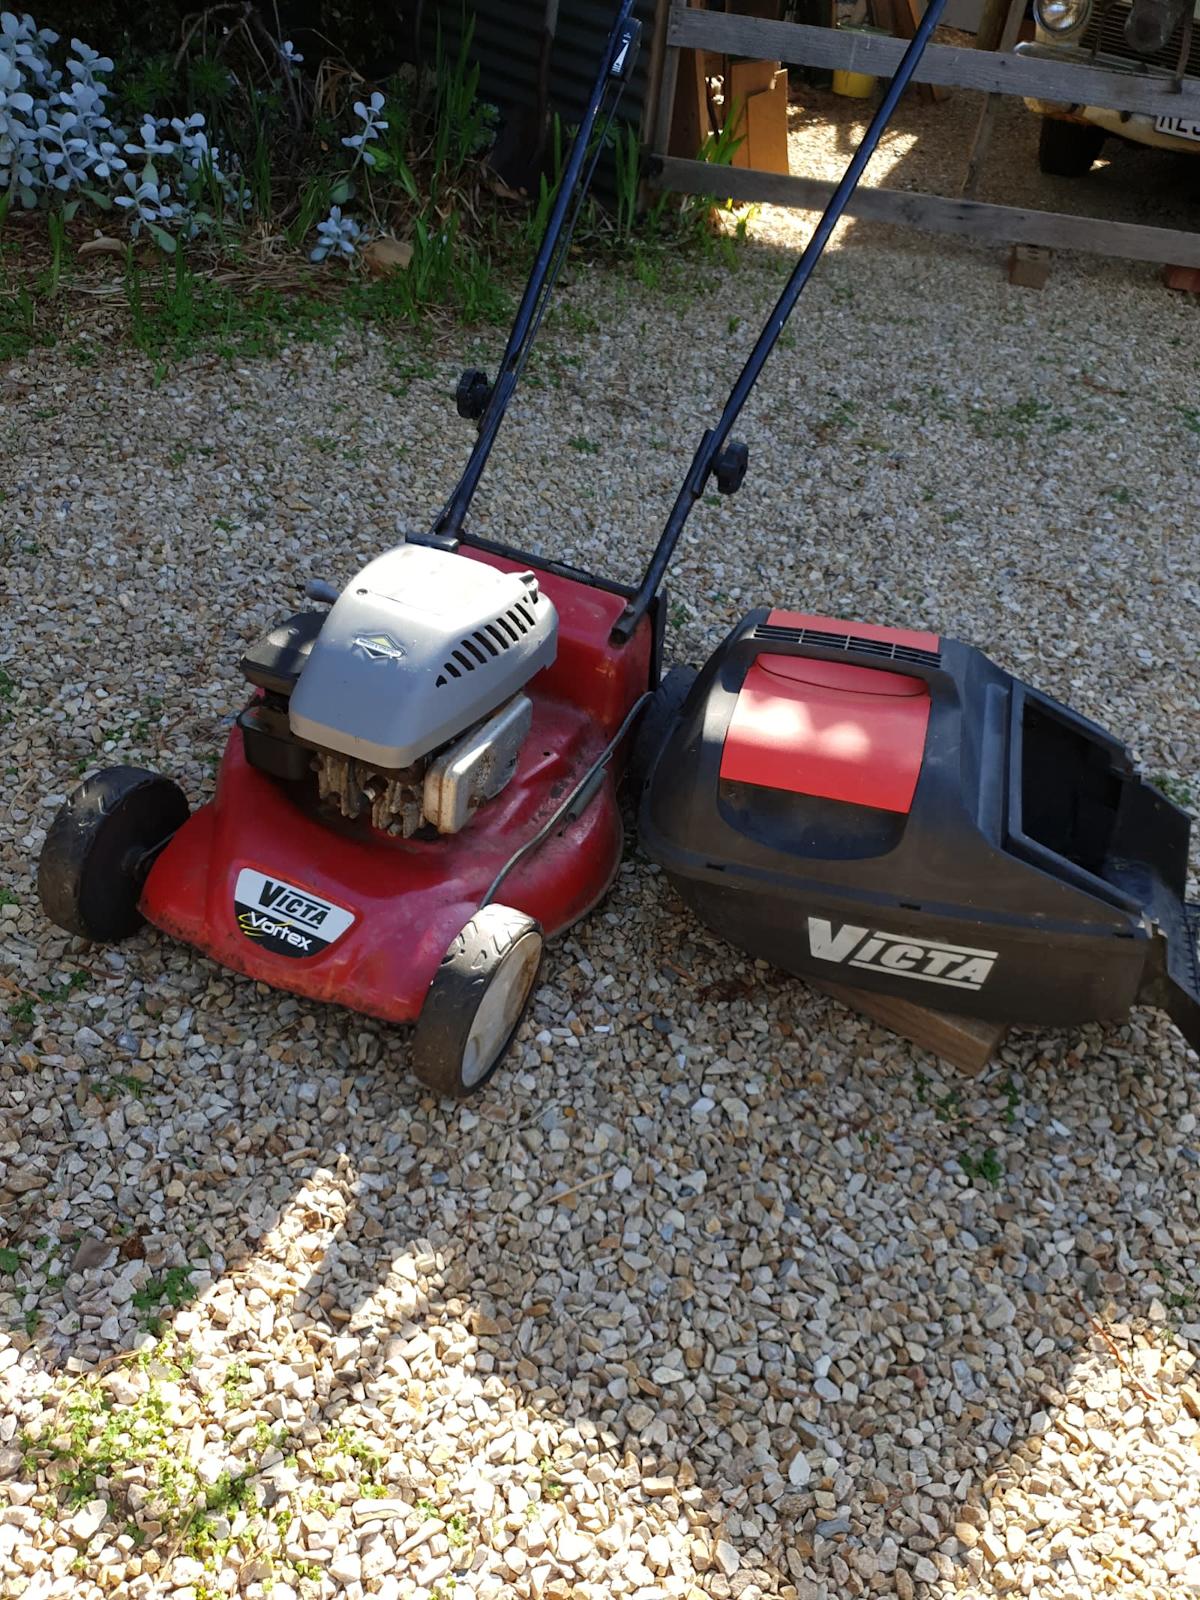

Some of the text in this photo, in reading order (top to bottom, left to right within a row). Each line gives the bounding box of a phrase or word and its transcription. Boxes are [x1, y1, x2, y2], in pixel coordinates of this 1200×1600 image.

[258, 880, 329, 926] VICTA
[250, 911, 313, 951] Vortex
[807, 916, 995, 984] VICTA
